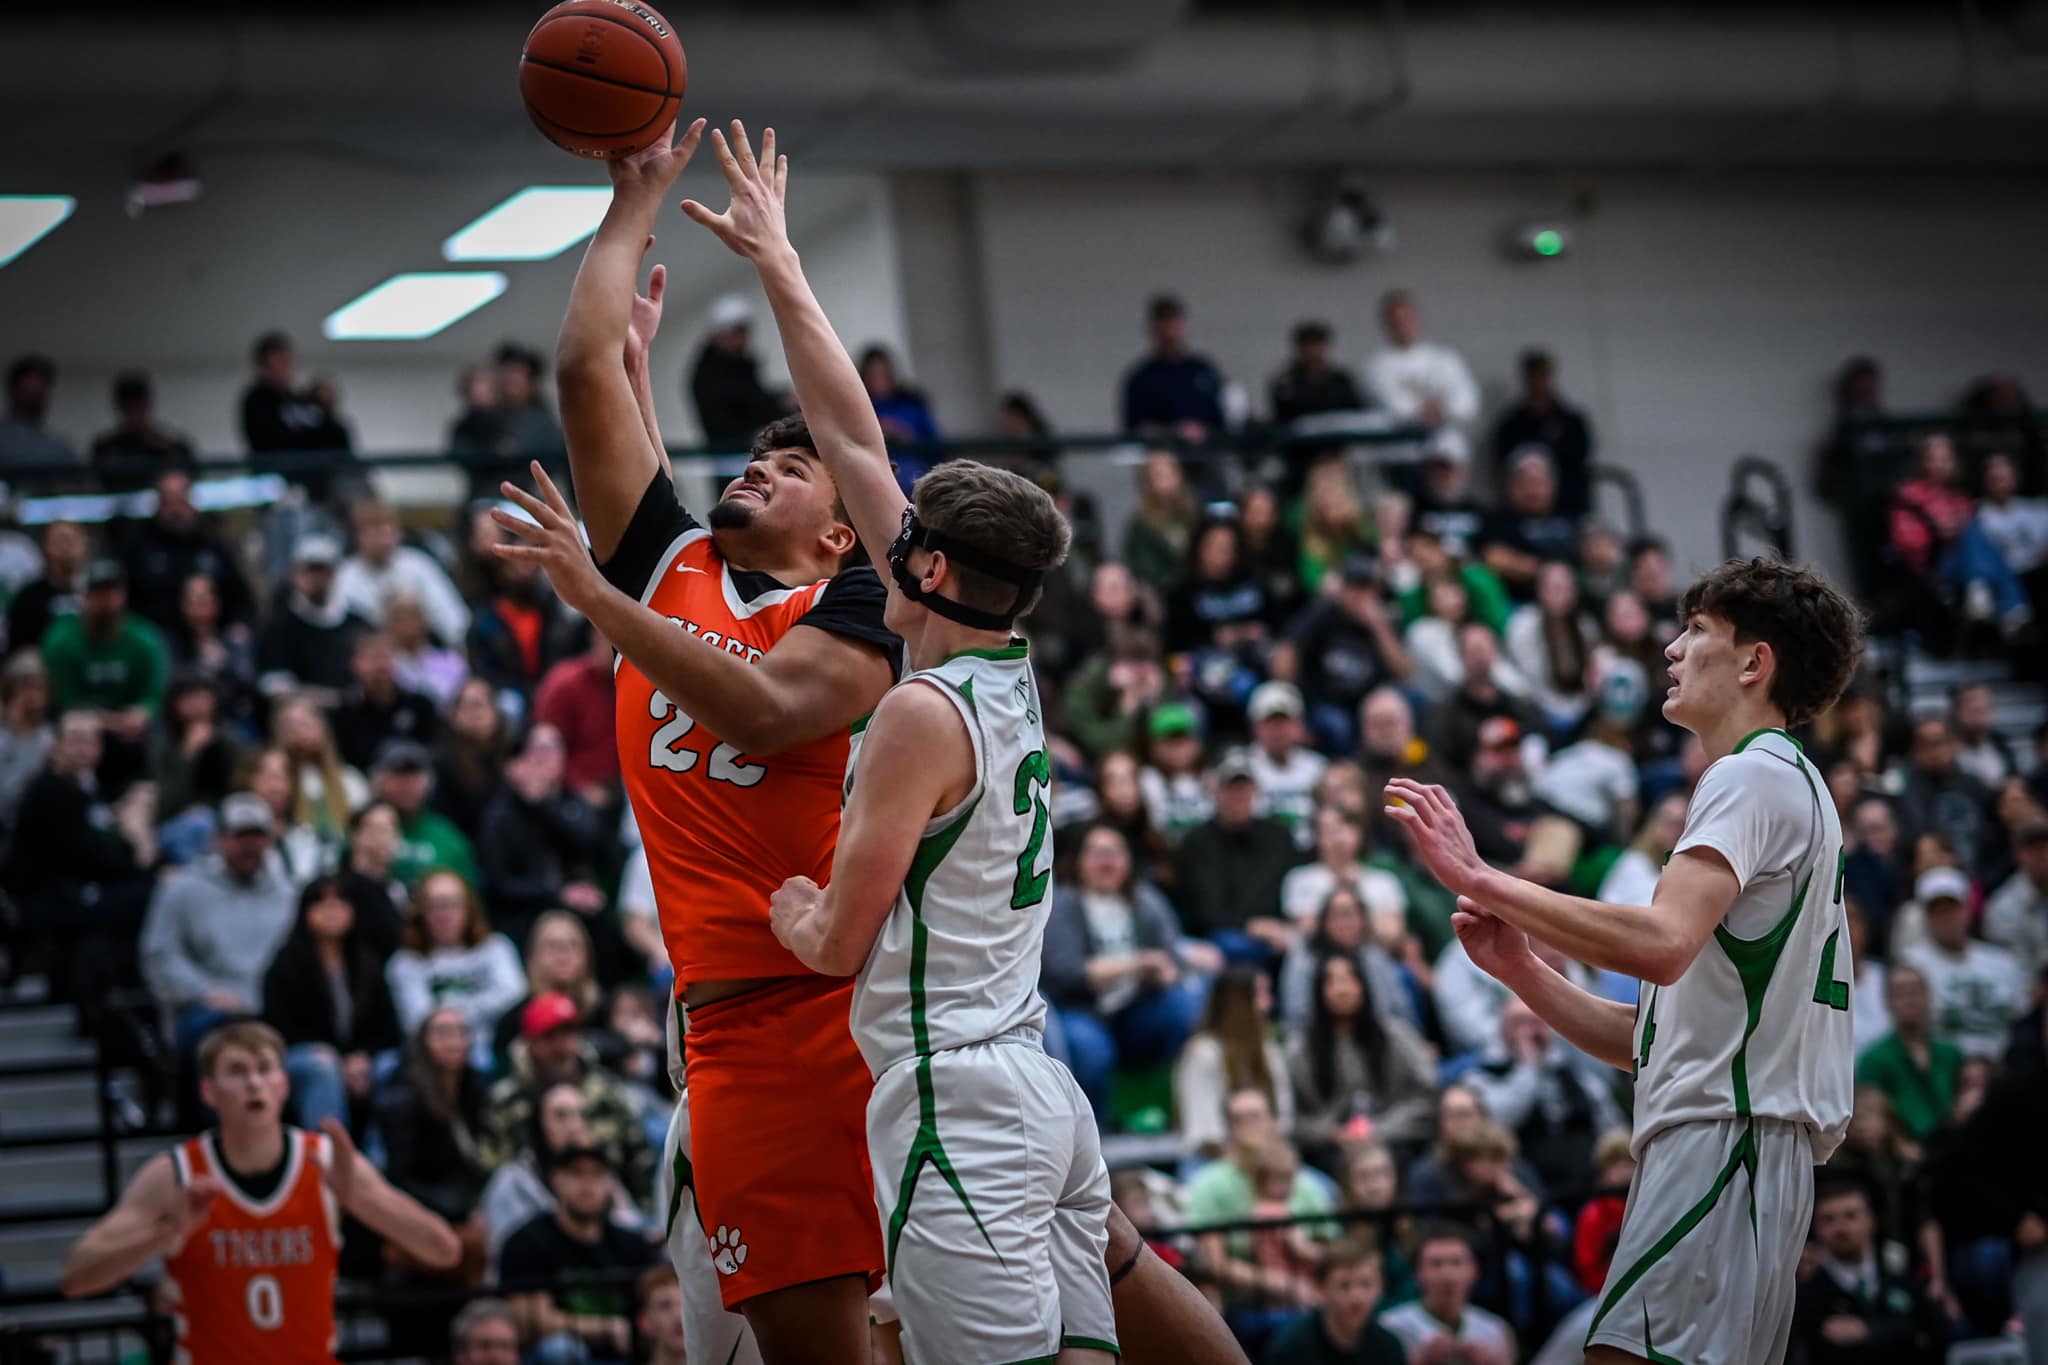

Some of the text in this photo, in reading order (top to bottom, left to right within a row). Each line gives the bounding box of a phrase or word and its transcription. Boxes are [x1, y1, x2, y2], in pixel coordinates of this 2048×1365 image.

[1010, 750, 1051, 910] 2
[209, 1225, 314, 1268] TIGERS
[246, 1274, 284, 1330] 0
